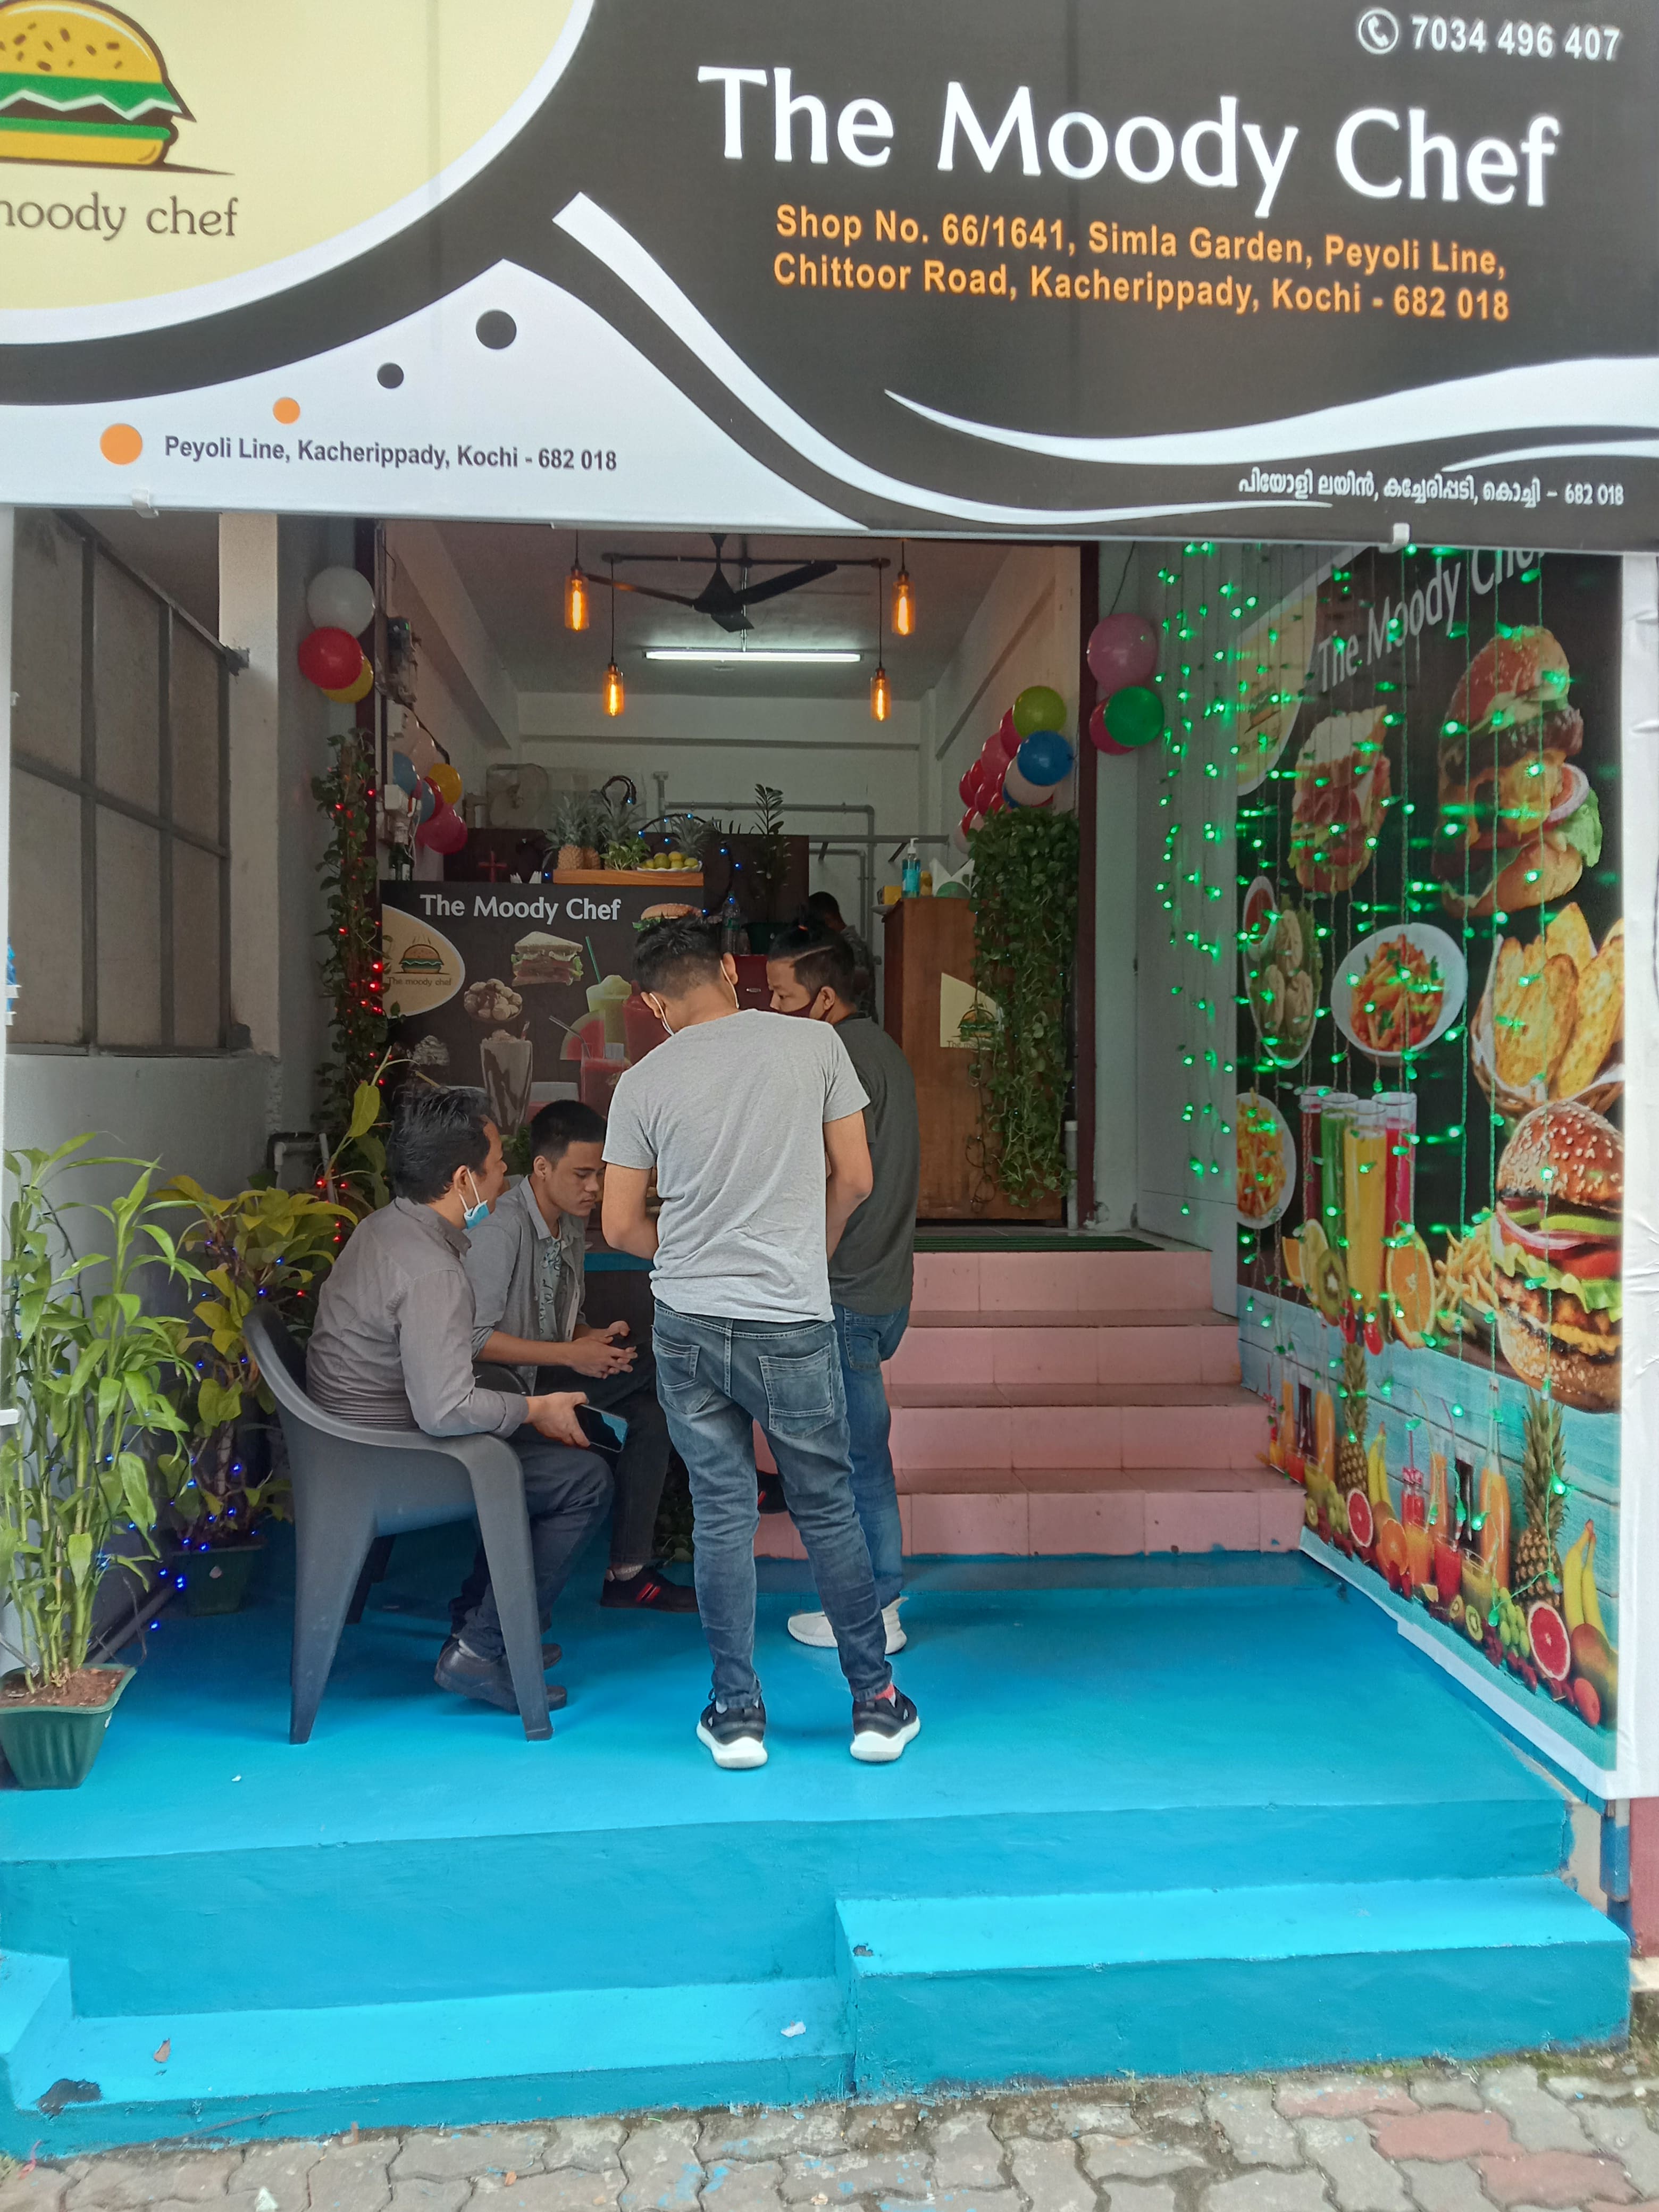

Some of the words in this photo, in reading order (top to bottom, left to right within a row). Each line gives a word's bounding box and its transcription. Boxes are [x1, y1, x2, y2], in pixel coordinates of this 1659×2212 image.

[1412, 16, 1487, 53] 7034
[1498, 22, 1553, 57] 496
[1564, 26, 1620, 61] 407
[697, 66, 894, 167] The
[937, 81, 1299, 218] Moody
[1336, 107, 1560, 207] Chef
[146, 195, 239, 236] chef
[776, 203, 864, 248] Shop
[875, 208, 929, 244] No.
[941, 212, 1076, 257] 66/1641,
[1088, 220, 1178, 257] Simla
[1188, 226, 1313, 270] Garden,
[1324, 233, 1420, 276] Peyoli
[1430, 241, 1506, 281] Line,
[773, 252, 912, 292] Chittoor
[923, 258, 1017, 303] Road,
[1029, 266, 1260, 316] Kacherippady,
[1271, 278, 1361, 314] Kochi
[1392, 284, 1446, 319] 682
[1456, 288, 1510, 322] 018
[165, 435, 231, 462] Peyoli
[239, 438, 290, 463] Line,
[298, 440, 450, 470] Kacherippady,
[458, 445, 517, 467] Kochi
[538, 448, 574, 468] 682
[581, 450, 617, 470] 018
[1238, 466, 1313, 499] പിയോളി
[1482, 477, 1540, 508] കൊച്ചി
[1564, 483, 1593, 505] 682
[1597, 484, 1624, 506] 018
[1318, 633, 1359, 692] The
[1367, 557, 1461, 665] Moody
[420, 894, 464, 916] The
[473, 896, 559, 925] Moody
[566, 898, 622, 920] Chef
[405, 978, 432, 986] moody
